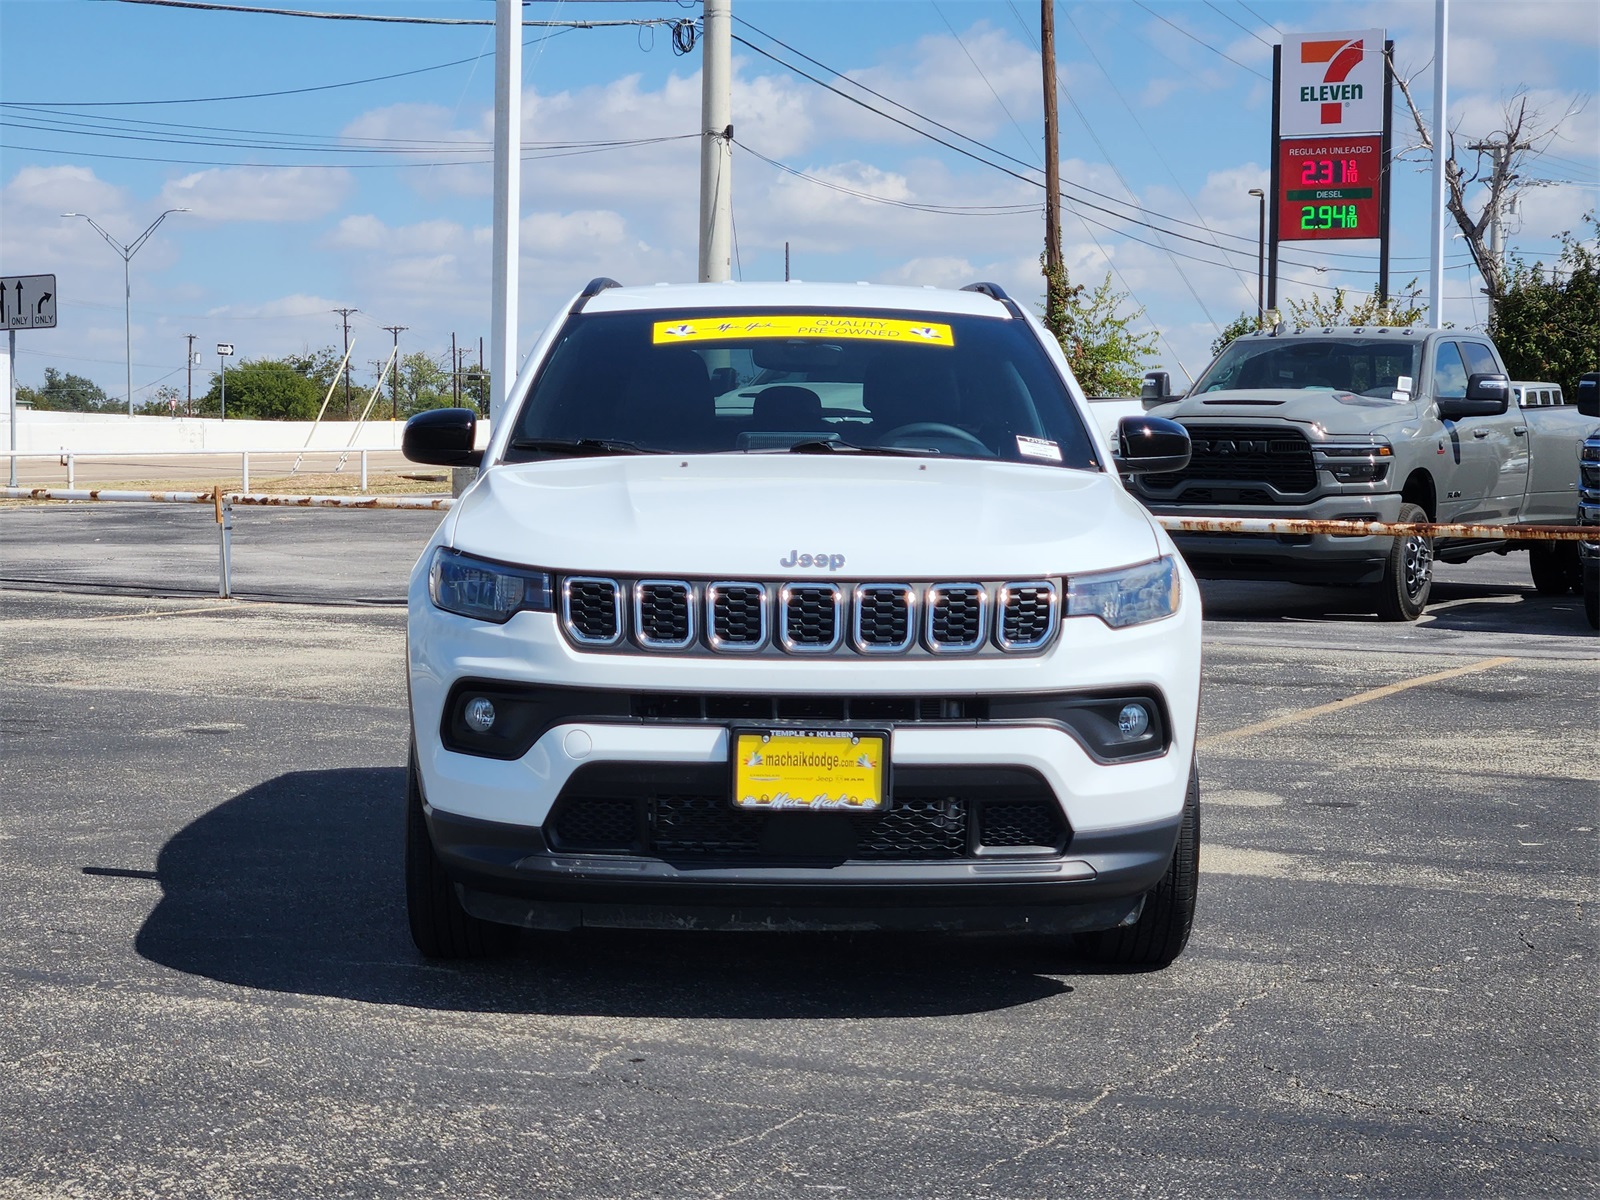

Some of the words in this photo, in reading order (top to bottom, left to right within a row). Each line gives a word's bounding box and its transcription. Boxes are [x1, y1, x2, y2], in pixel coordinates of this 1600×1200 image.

[1289, 148, 1327, 156] REGULAR
[1329, 146, 1372, 154] UNLEADED
[1316, 191, 1342, 199] DIESEL
[1301, 206, 1346, 230] 2.94
[11, 317, 28, 325] ONLY
[34, 315, 53, 324] ONLY
[816, 319, 888, 328] QUALITY
[798, 327, 900, 336] PRE-OWNED
[780, 549, 846, 571] Jeep
[765, 752, 854, 771] machaikdodge.com
[816, 775, 833, 783] Jeep
